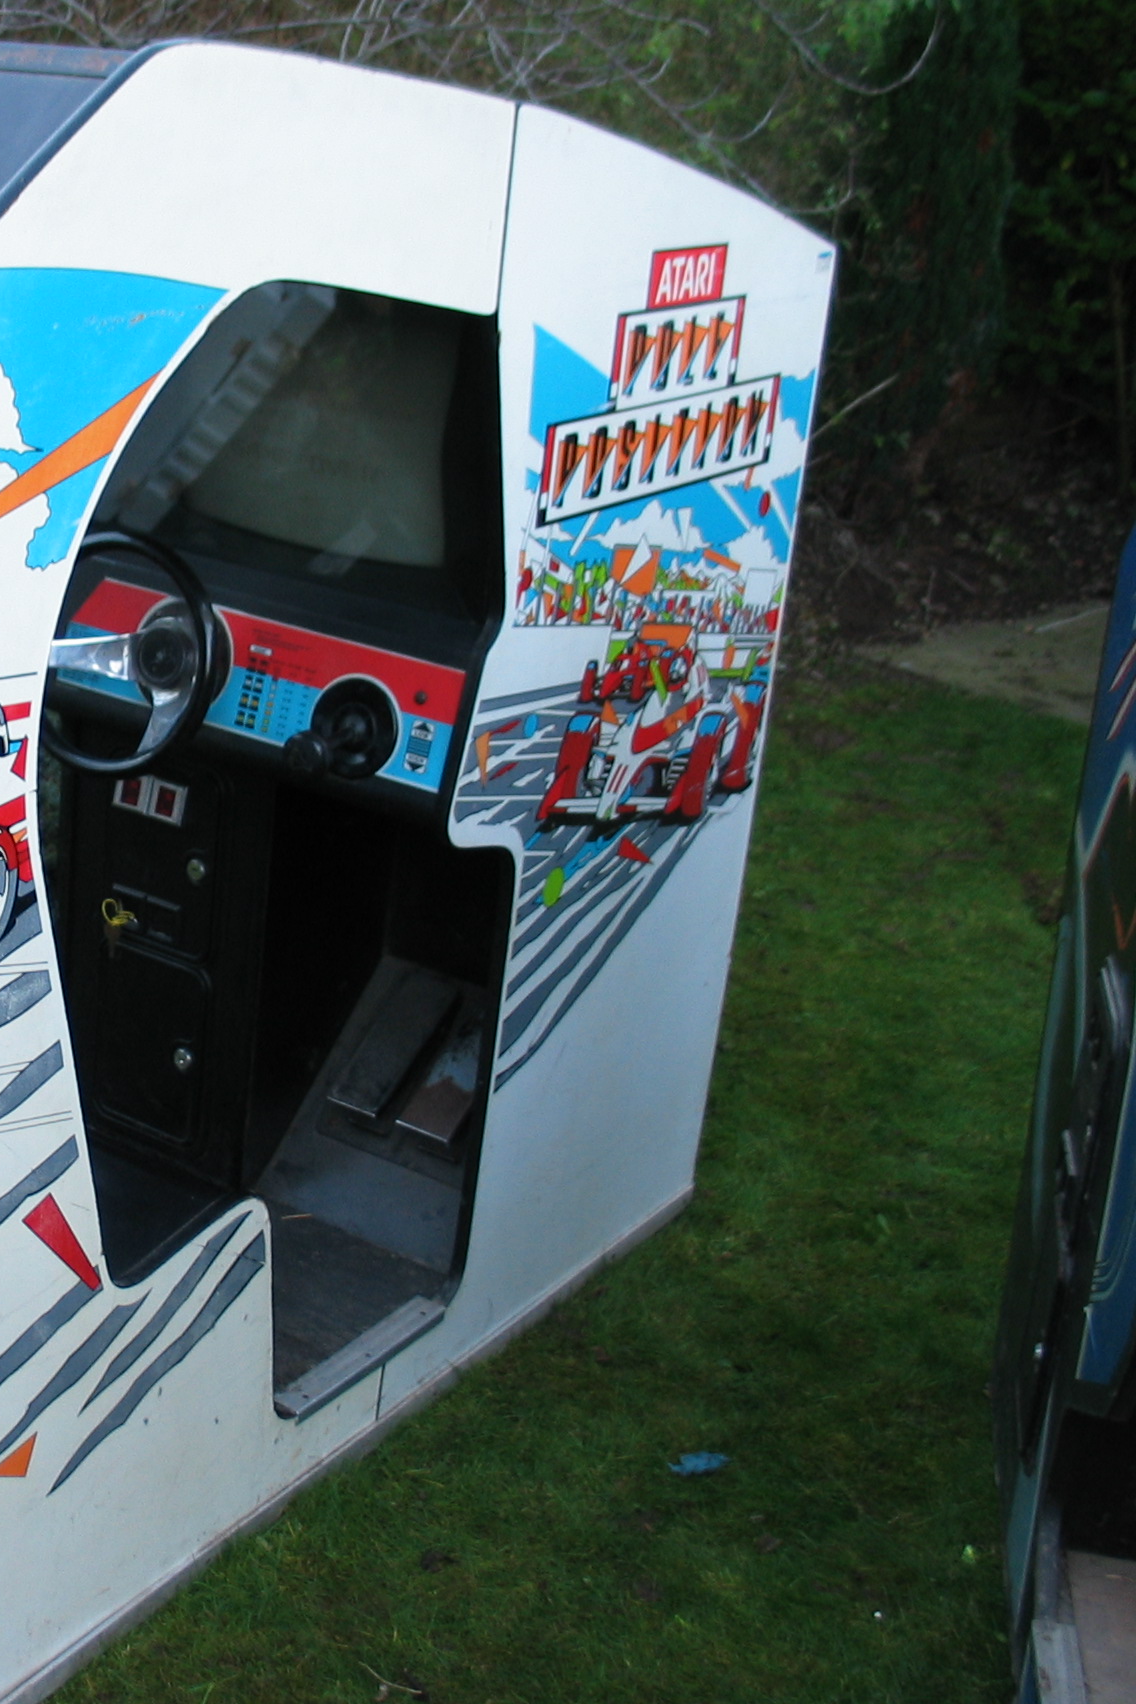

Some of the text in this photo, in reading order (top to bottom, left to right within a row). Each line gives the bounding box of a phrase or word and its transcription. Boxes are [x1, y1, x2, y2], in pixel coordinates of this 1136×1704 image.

[656, 252, 716, 304] ATARI
[623, 311, 734, 396] POLE
[552, 388, 769, 508] POSITION
